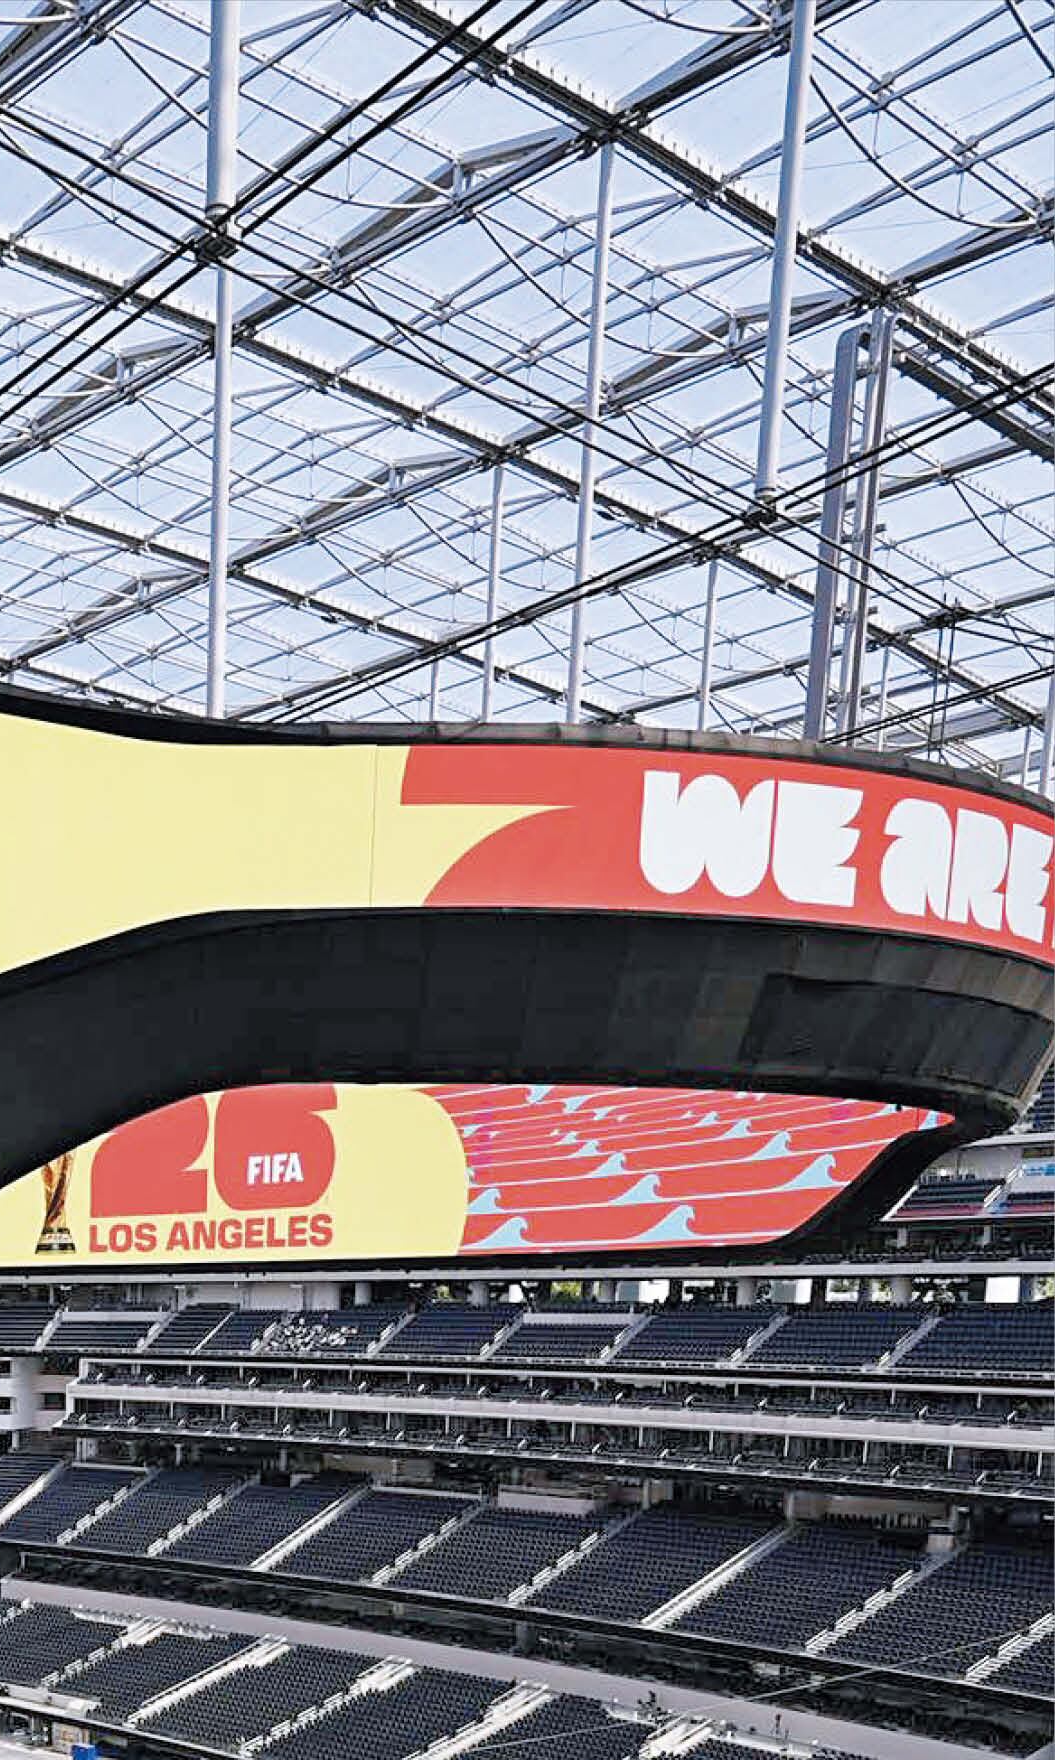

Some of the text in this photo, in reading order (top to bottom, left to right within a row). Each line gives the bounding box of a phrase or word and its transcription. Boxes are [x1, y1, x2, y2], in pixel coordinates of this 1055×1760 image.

[640, 770, 864, 908] WE
[90, 1084, 338, 1218] 26
[246, 1152, 304, 1186] FIFA
[89, 1213, 333, 1253] LOS ANGELES
